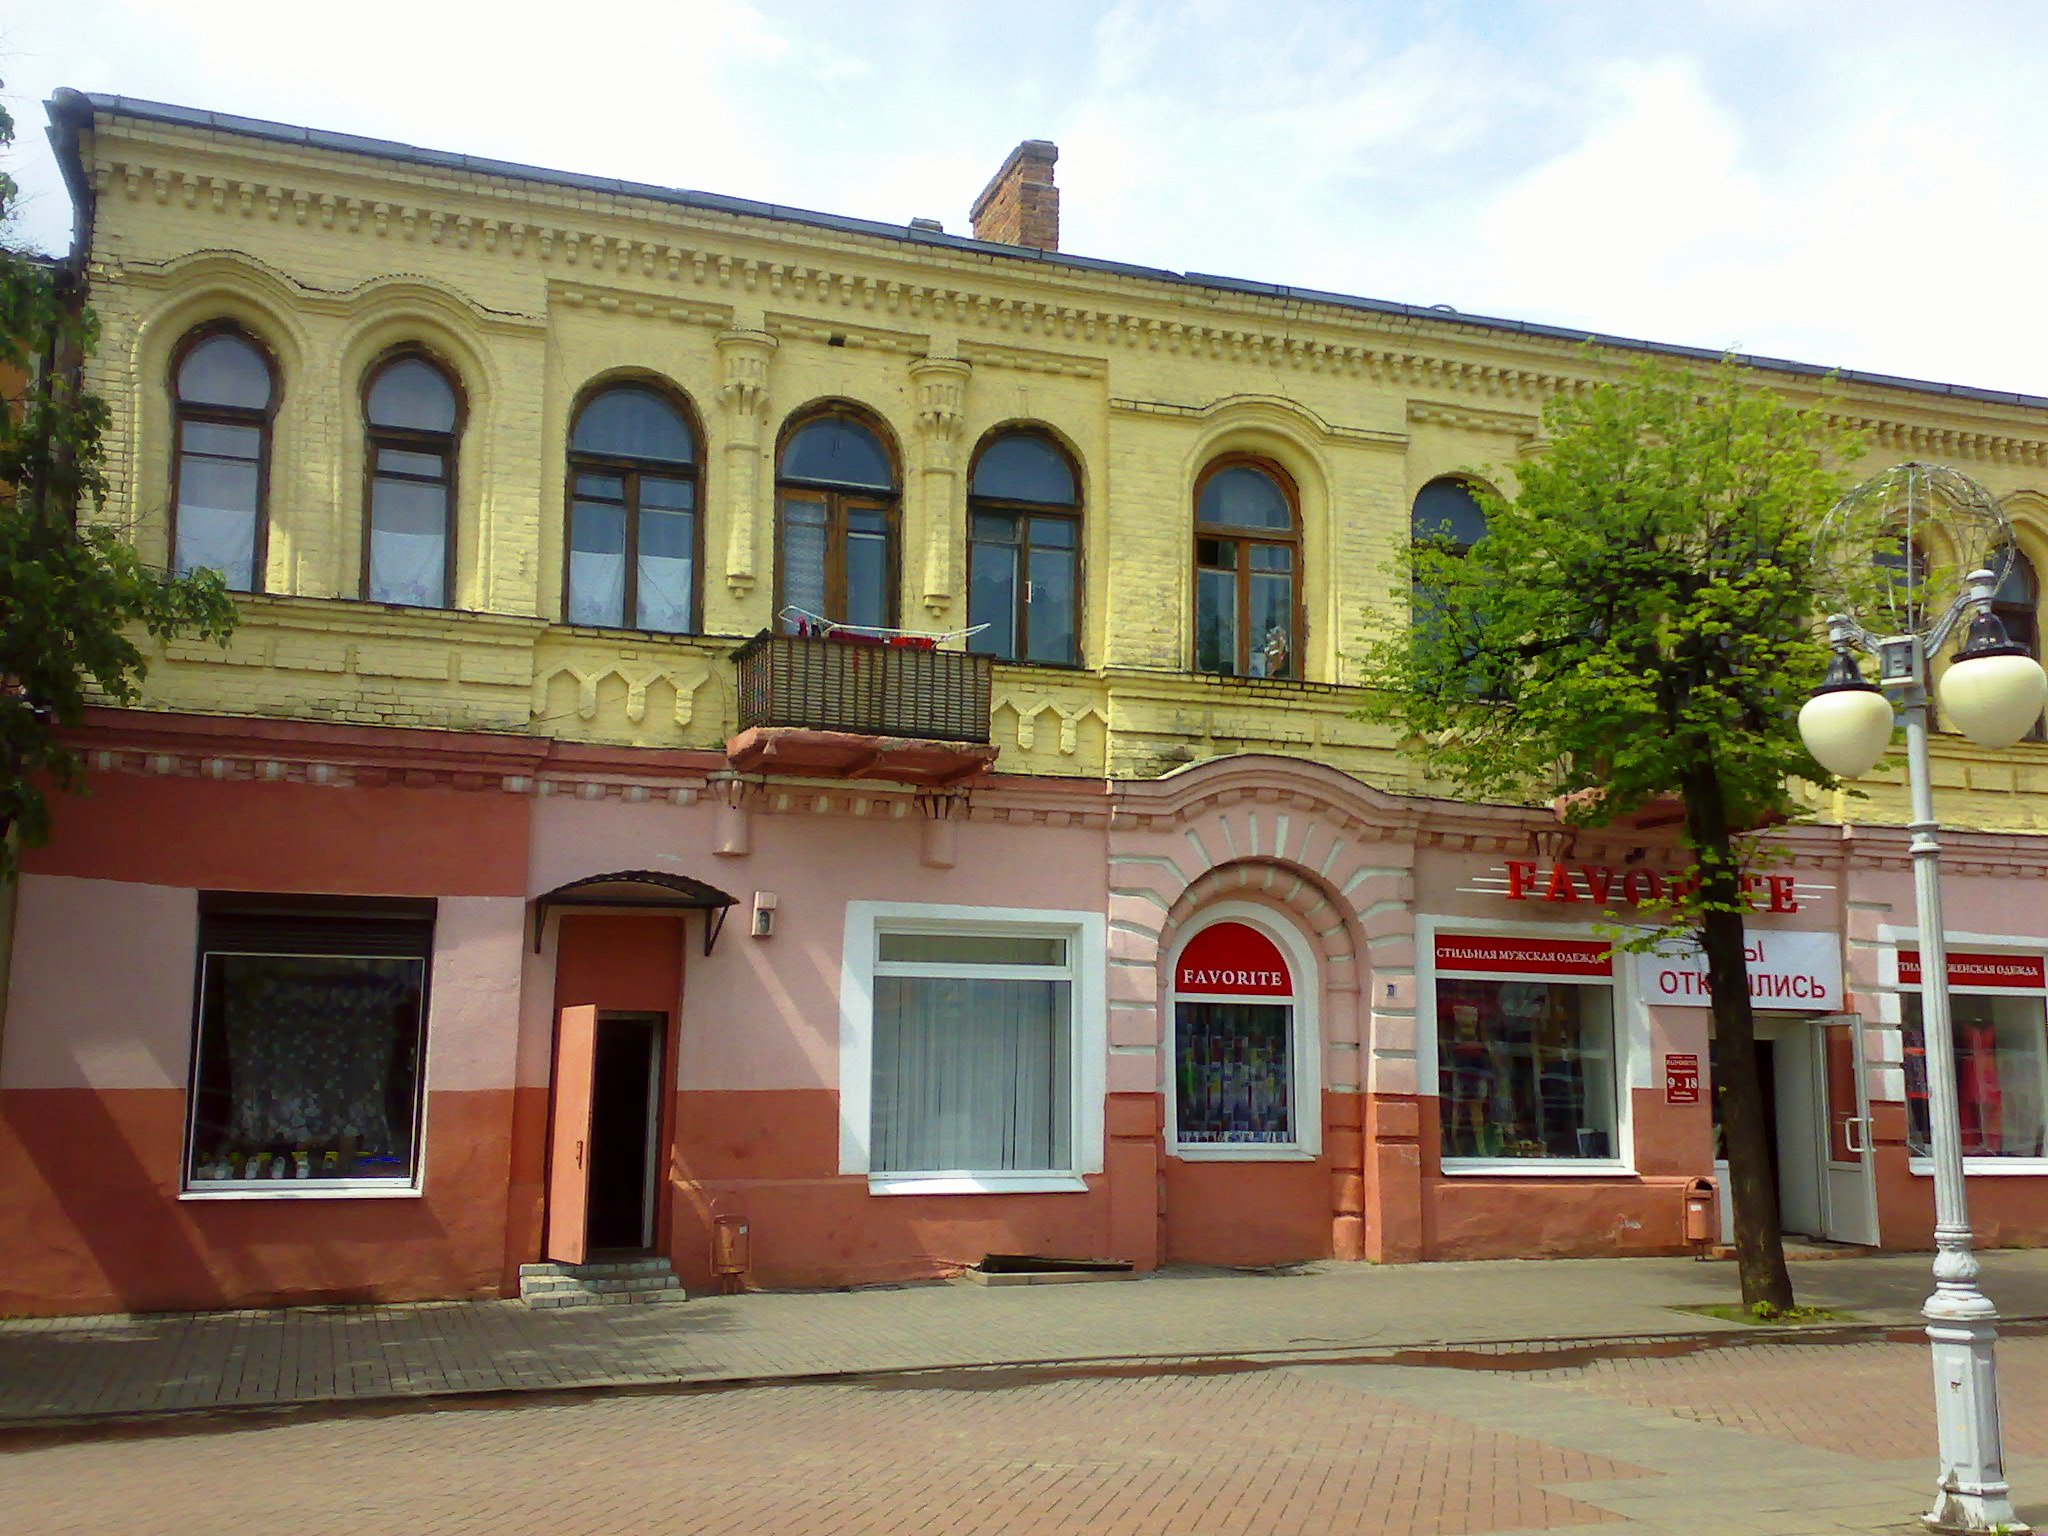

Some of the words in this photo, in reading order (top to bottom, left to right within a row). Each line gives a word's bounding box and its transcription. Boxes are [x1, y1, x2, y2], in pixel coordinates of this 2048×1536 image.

[1504, 860, 1798, 913] FAVORTE
[1436, 947, 1497, 960] СТИЛЬНАЯ
[1499, 950, 1555, 962] МУЖСКАЯ
[1183, 969, 1282, 986] FAVORITE
[1996, 965, 2039, 976] ОДЕЖДА
[1659, 970, 1826, 998] ОТКЛИСЬ
[1667, 1077, 1676, 1089] 9
[1685, 1077, 1698, 1089] 18
